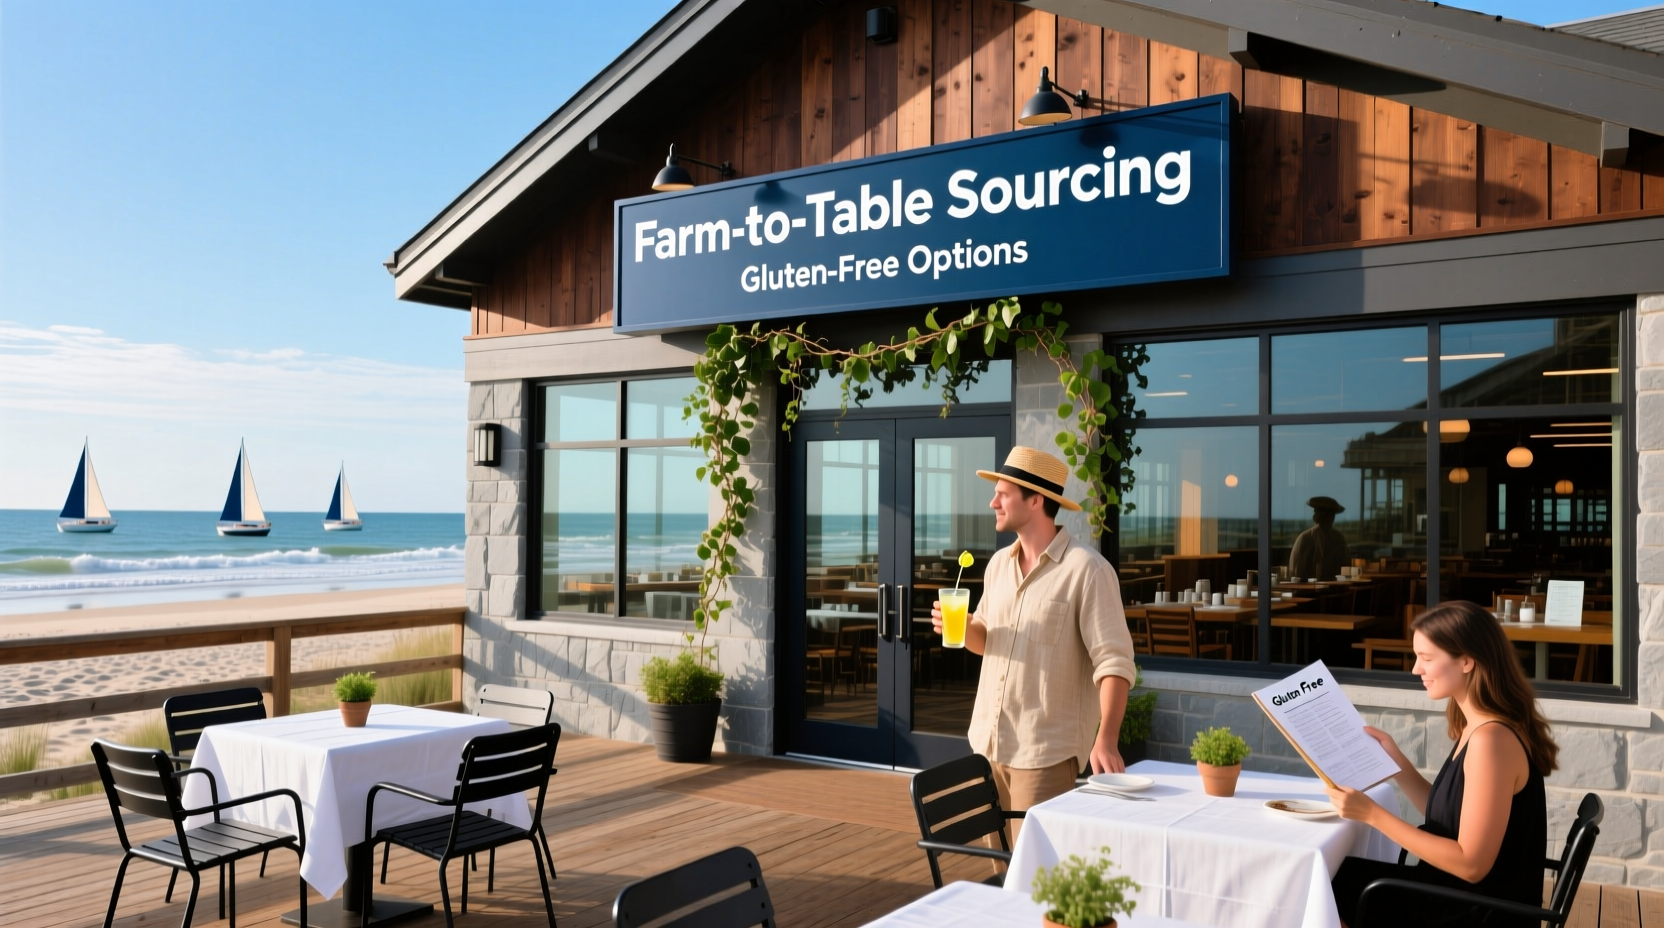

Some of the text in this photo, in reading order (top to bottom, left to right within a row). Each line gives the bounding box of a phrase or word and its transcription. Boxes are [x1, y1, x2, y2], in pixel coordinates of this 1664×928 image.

[634, 145, 1191, 263] Farm-to-Table Sourcing
[740, 240, 1029, 293] Gluten-Free Options
